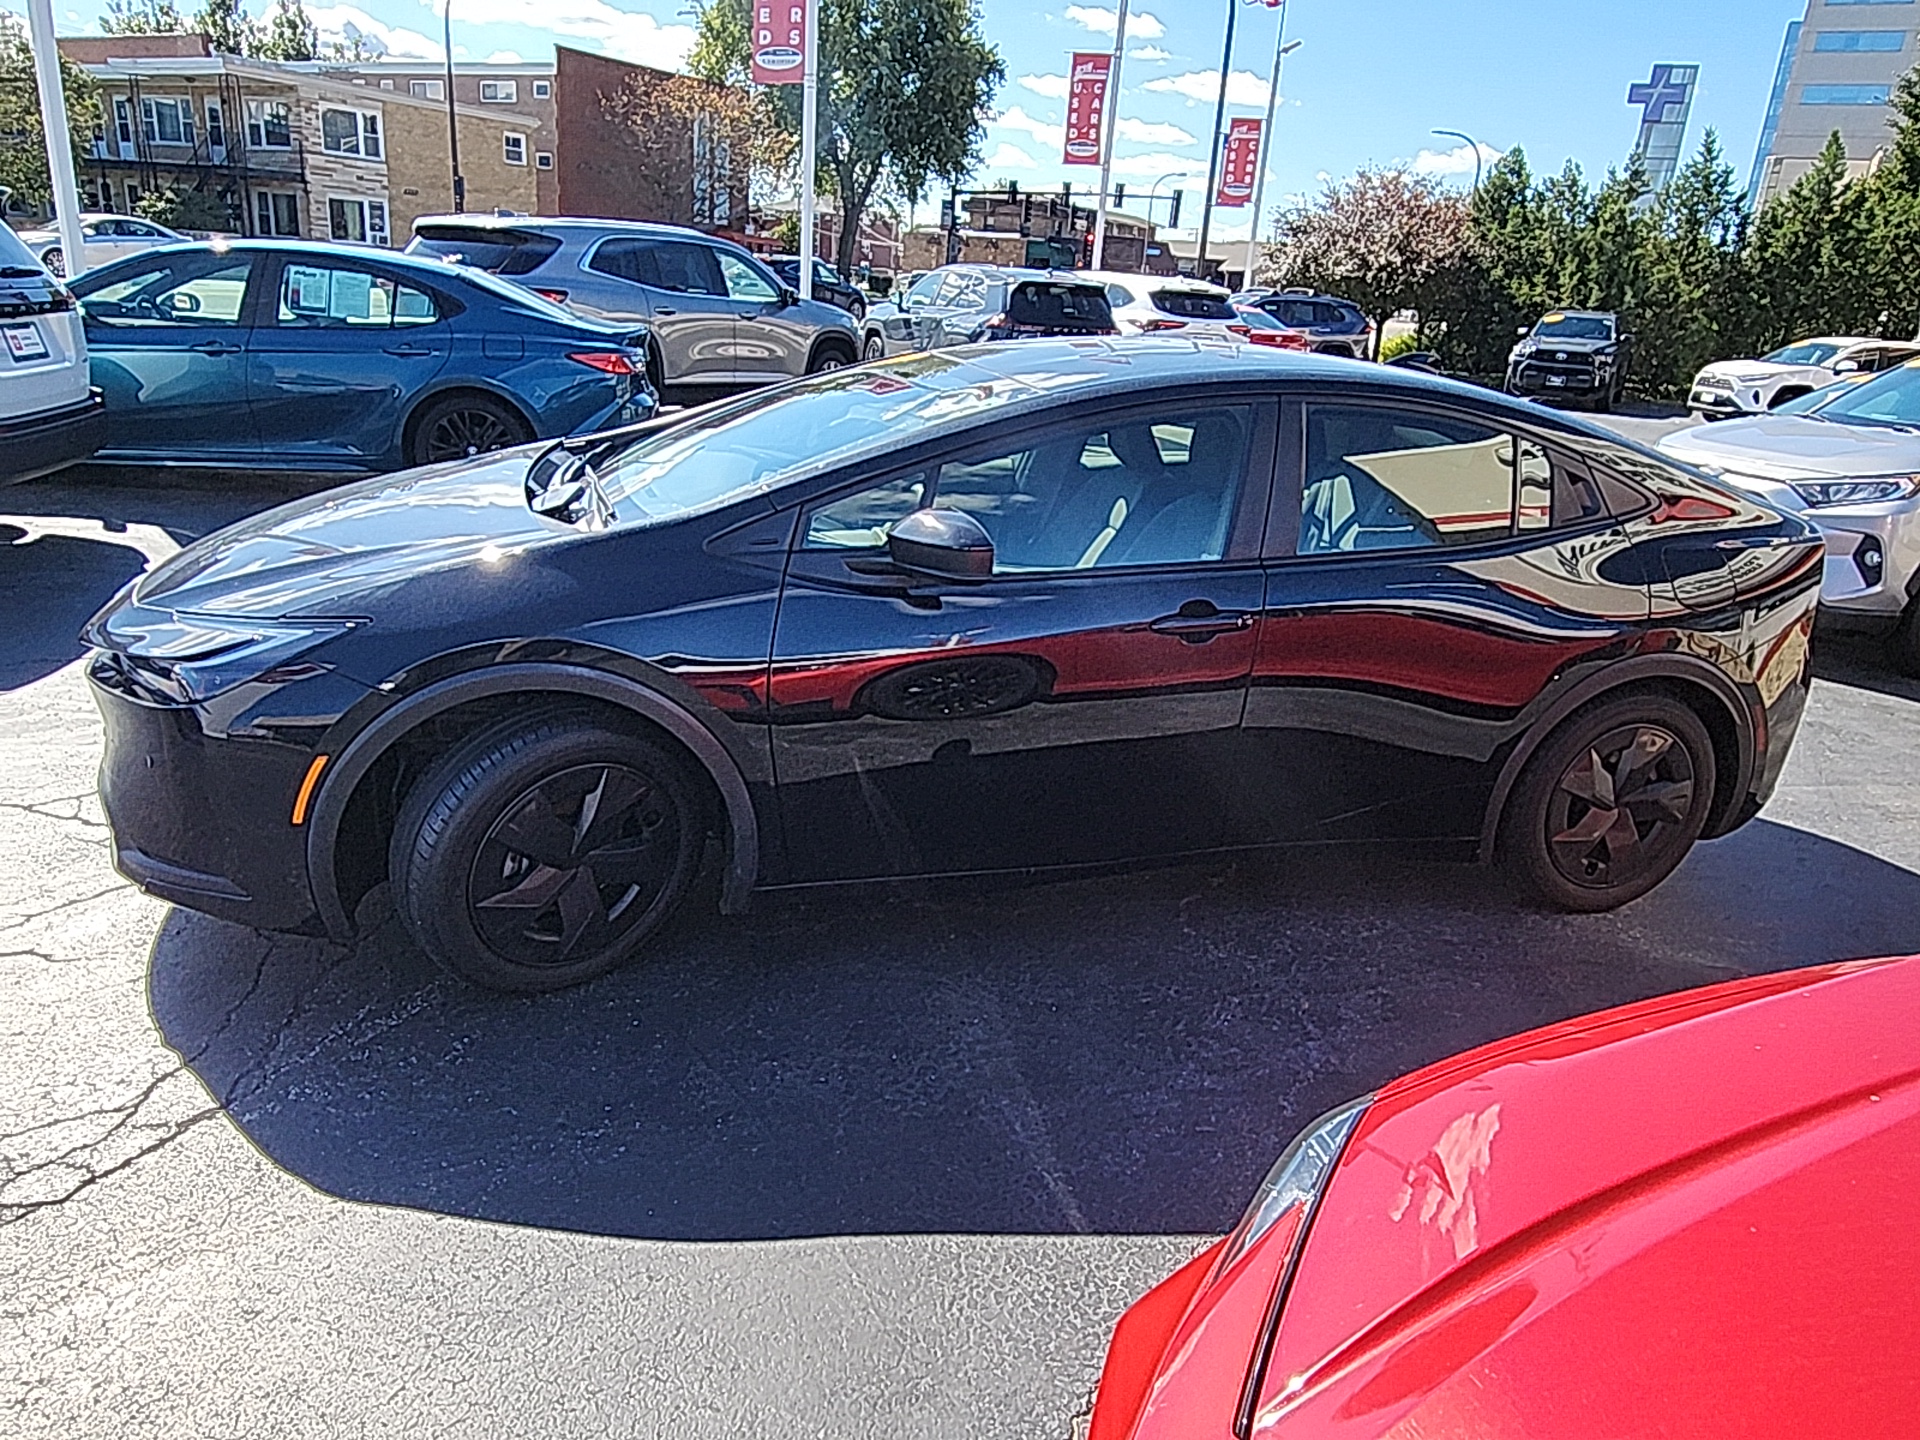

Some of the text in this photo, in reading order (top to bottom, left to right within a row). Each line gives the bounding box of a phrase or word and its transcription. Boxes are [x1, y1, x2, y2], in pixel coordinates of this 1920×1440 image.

[759, 0, 771, 45] ED
[1068, 82, 1083, 139] USED
[1088, 83, 1103, 140] CARS
